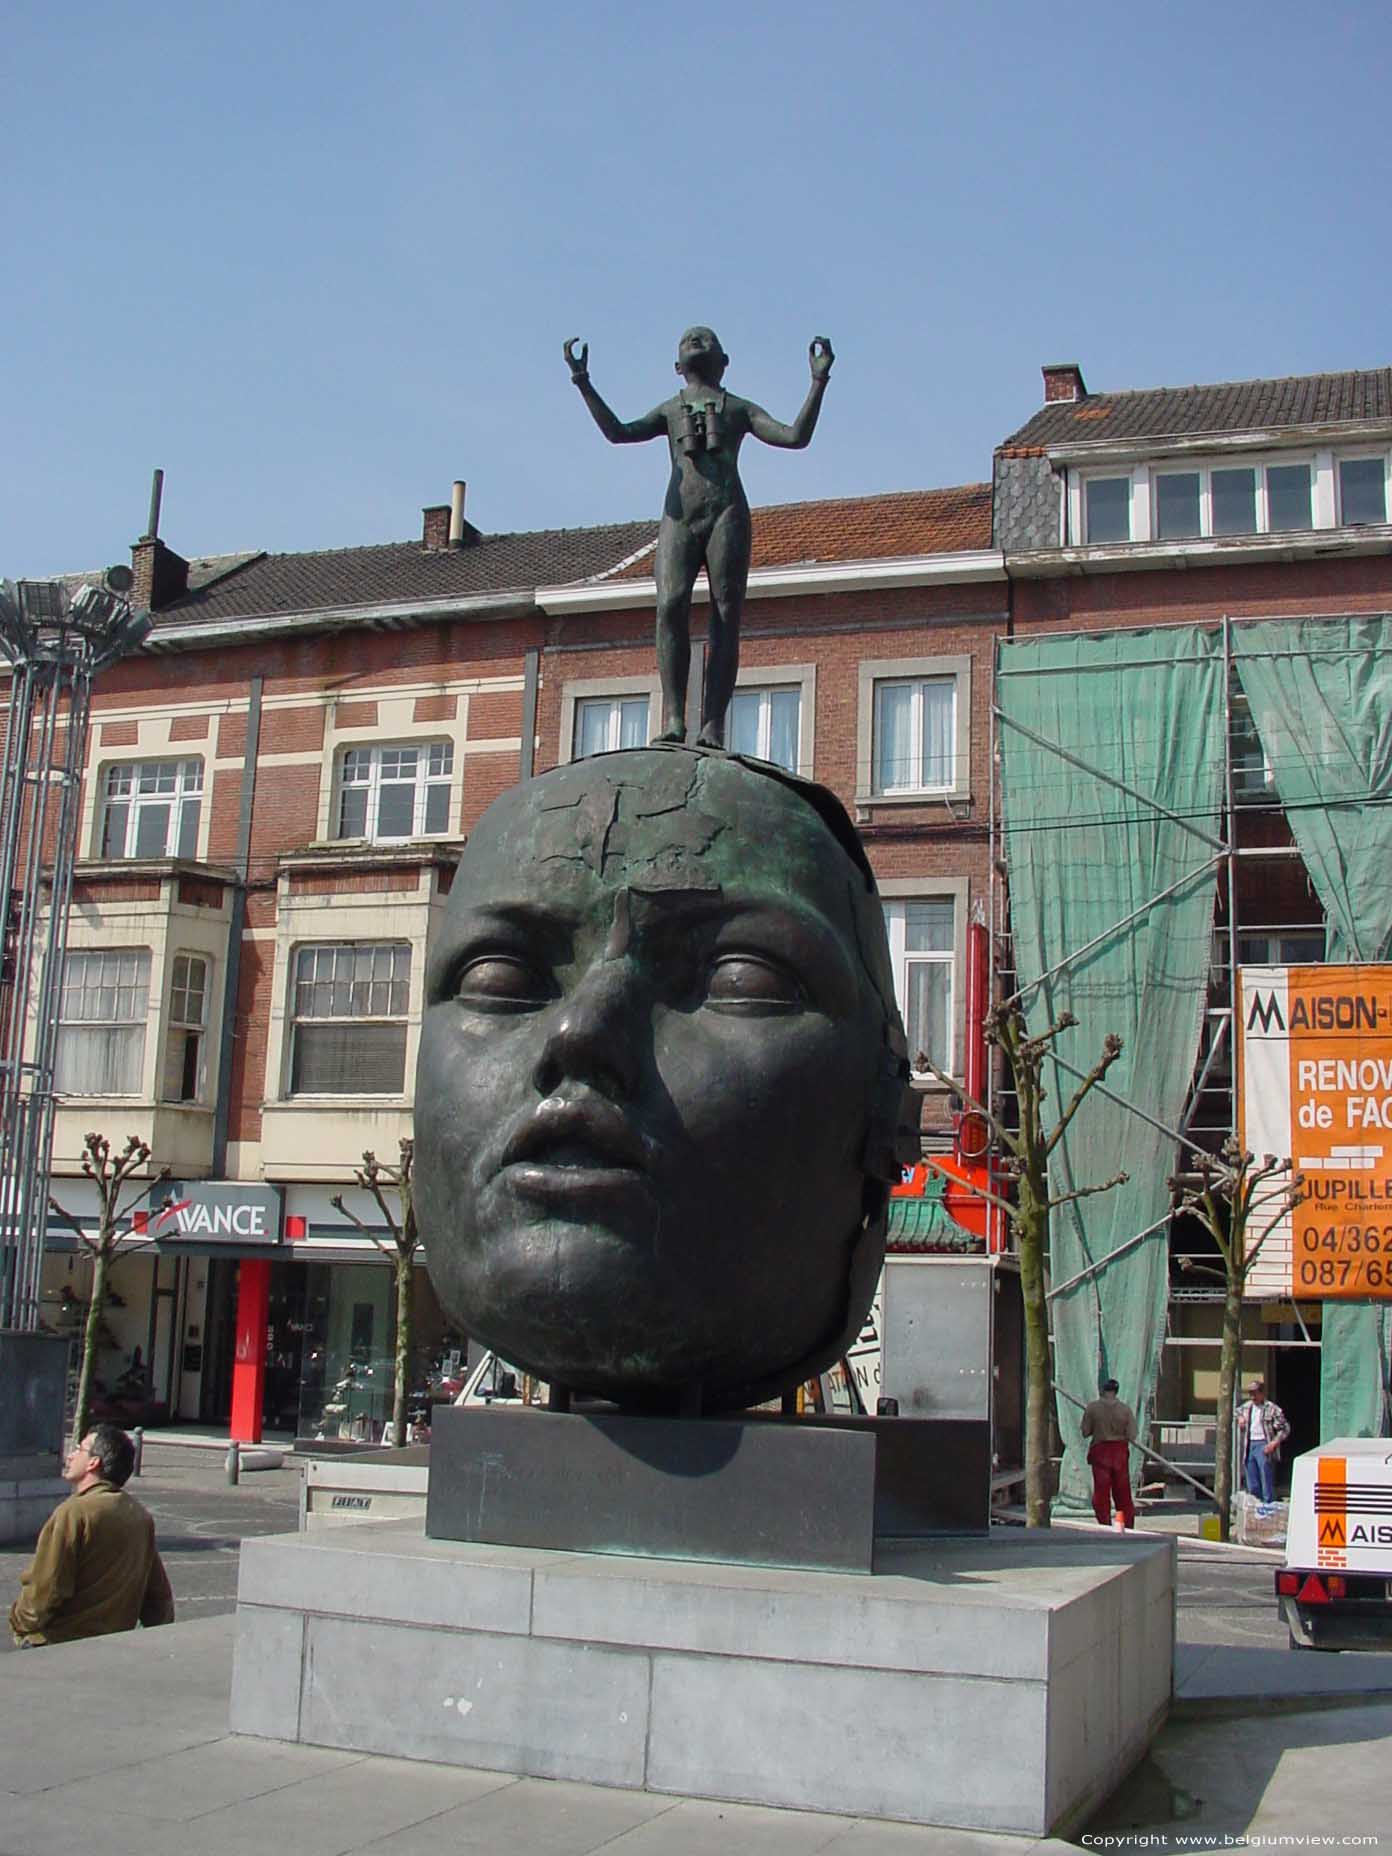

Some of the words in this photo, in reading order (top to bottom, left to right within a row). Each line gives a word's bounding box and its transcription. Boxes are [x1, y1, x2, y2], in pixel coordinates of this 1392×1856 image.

[1246, 989, 1392, 1034] MAISON-
[1297, 1058, 1392, 1092] RENOV
[1297, 1098, 1334, 1129] de
[1303, 1178, 1392, 1200] JUPILLE
[1314, 1202, 1338, 1213] Rue
[1302, 1225, 1392, 1253] 04/362
